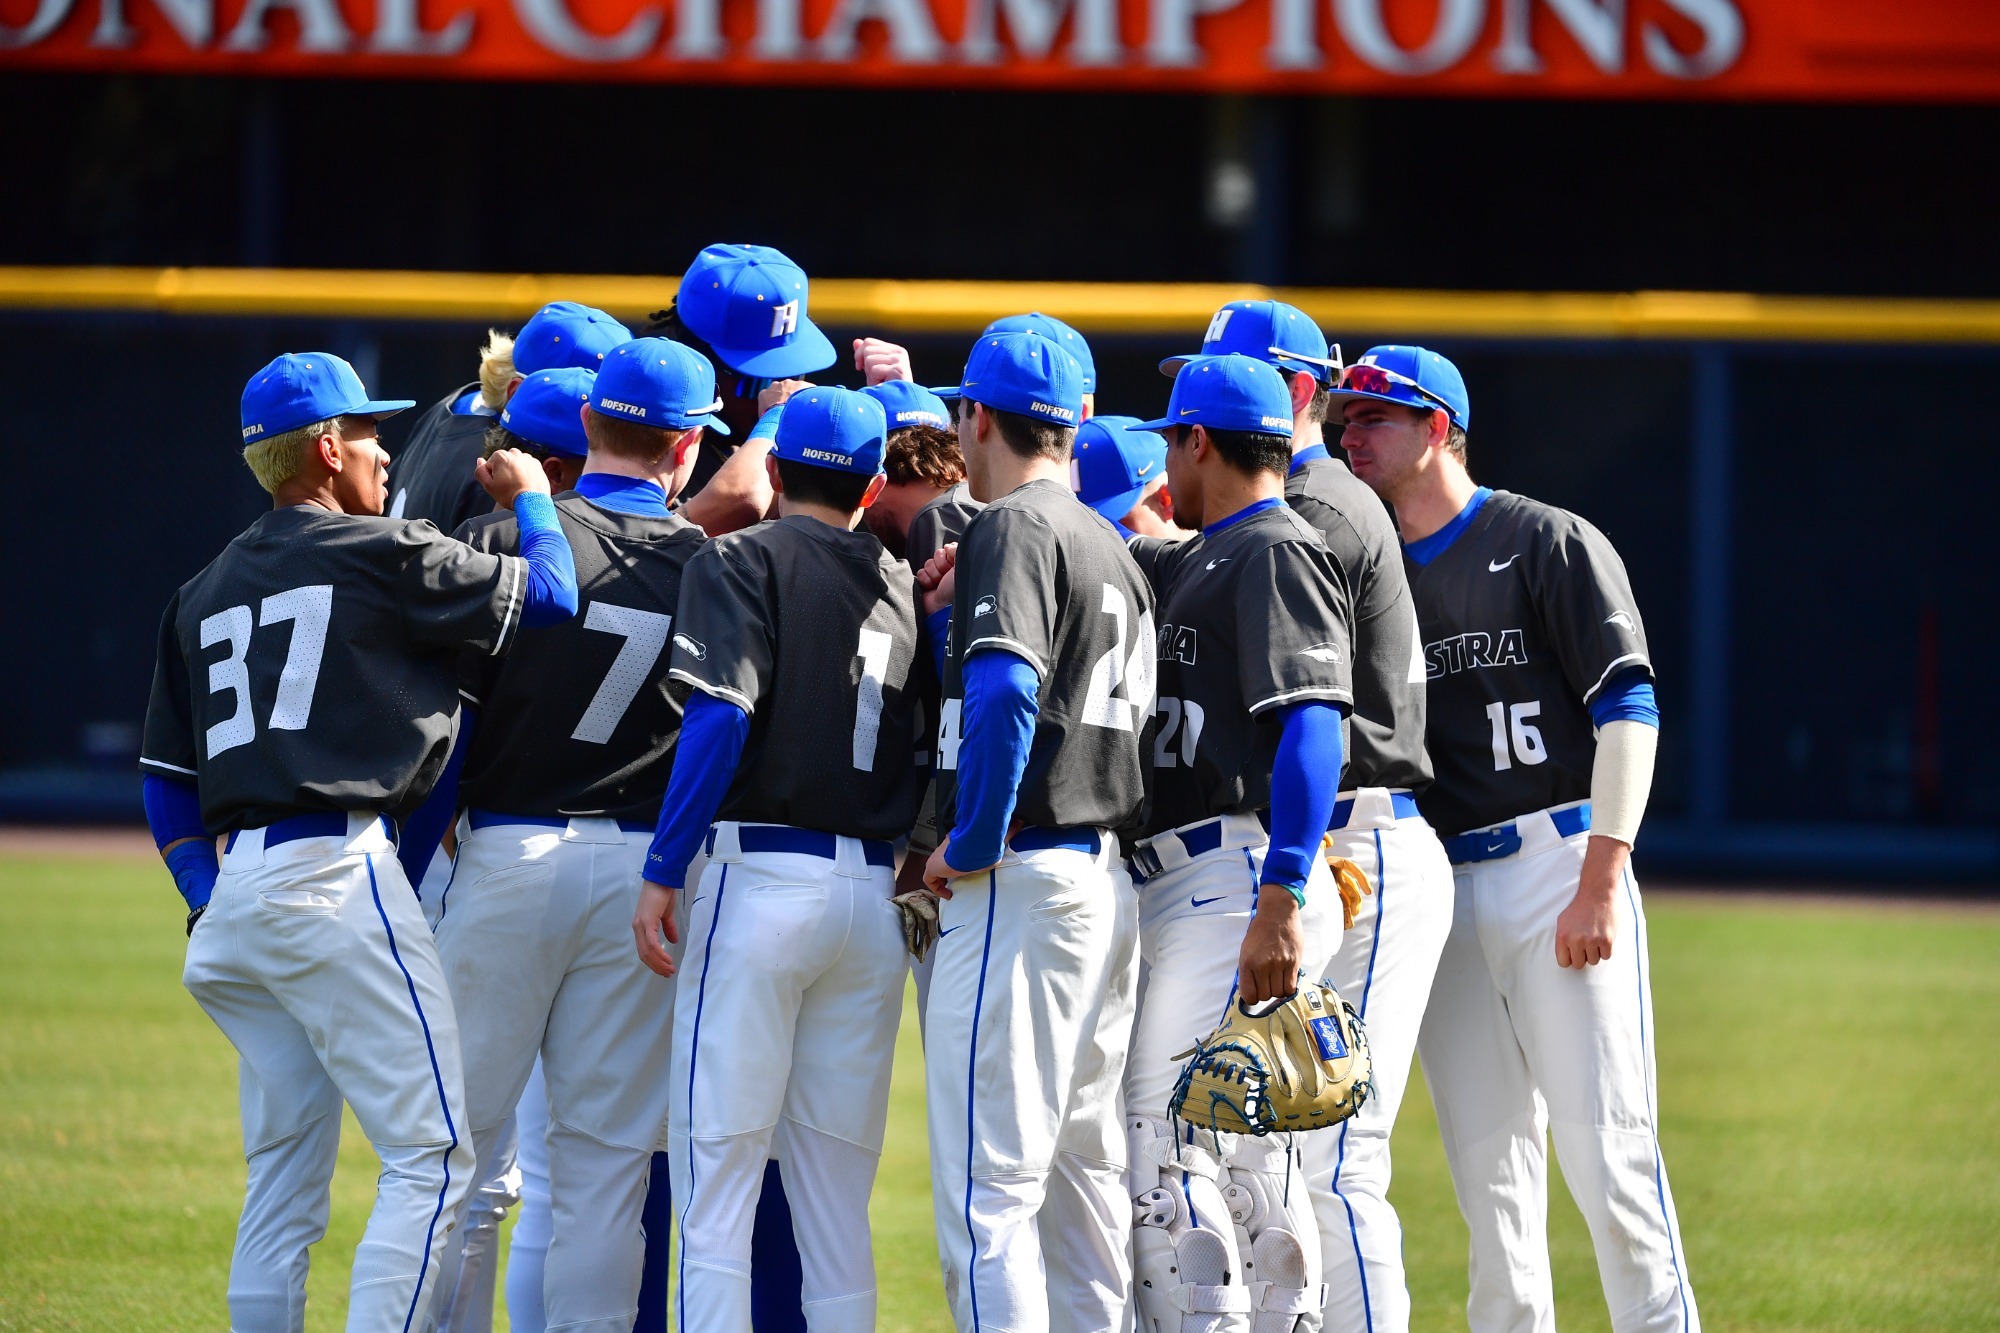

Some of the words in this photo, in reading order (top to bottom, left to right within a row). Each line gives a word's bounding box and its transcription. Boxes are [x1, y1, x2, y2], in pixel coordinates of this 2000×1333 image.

[770, 299, 799, 338] H
[1203, 309, 1235, 343] H
[600, 397, 647, 418] HOFSTRA
[1030, 401, 1075, 421] HOFSTRA
[802, 447, 853, 466] HOFSTRA
[200, 584, 334, 761] 37
[569, 600, 673, 745] 7
[1424, 628, 1529, 680] STRA
[853, 627, 893, 773] 1
[1485, 700, 1549, 772] 16
